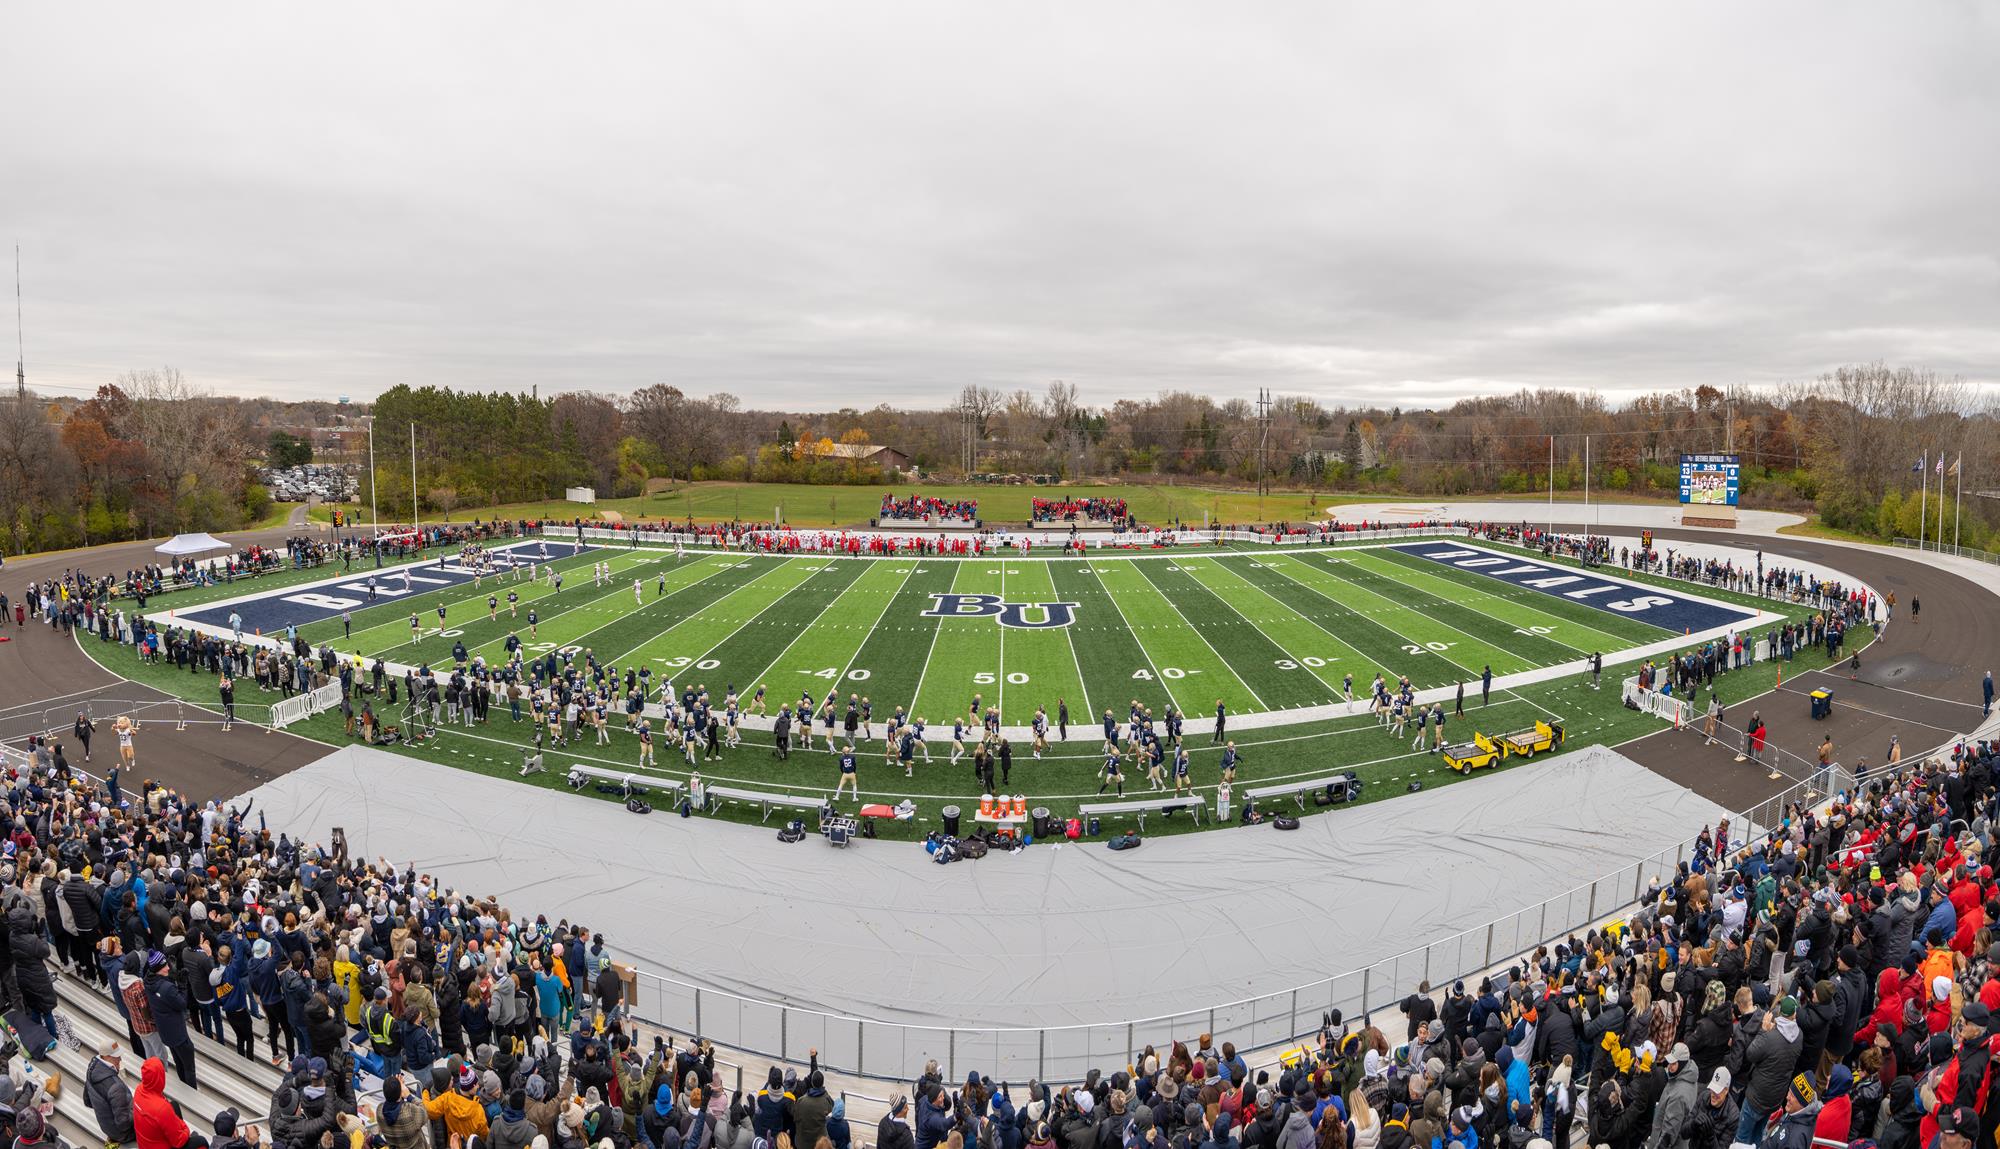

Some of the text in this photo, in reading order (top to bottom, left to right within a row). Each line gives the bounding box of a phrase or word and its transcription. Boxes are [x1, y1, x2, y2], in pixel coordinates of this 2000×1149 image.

[1422, 550, 1674, 612] ROYALS
[920, 593, 1082, 629] BU
[1513, 625, 1552, 637] 10
[528, 641, 583, 654] 20
[1401, 641, 1449, 656] 20
[665, 656, 721, 670] 30
[1274, 656, 1327, 670] 30
[814, 667, 871, 681] 40
[972, 672, 1030, 684] 50
[1131, 667, 1187, 681] 40
